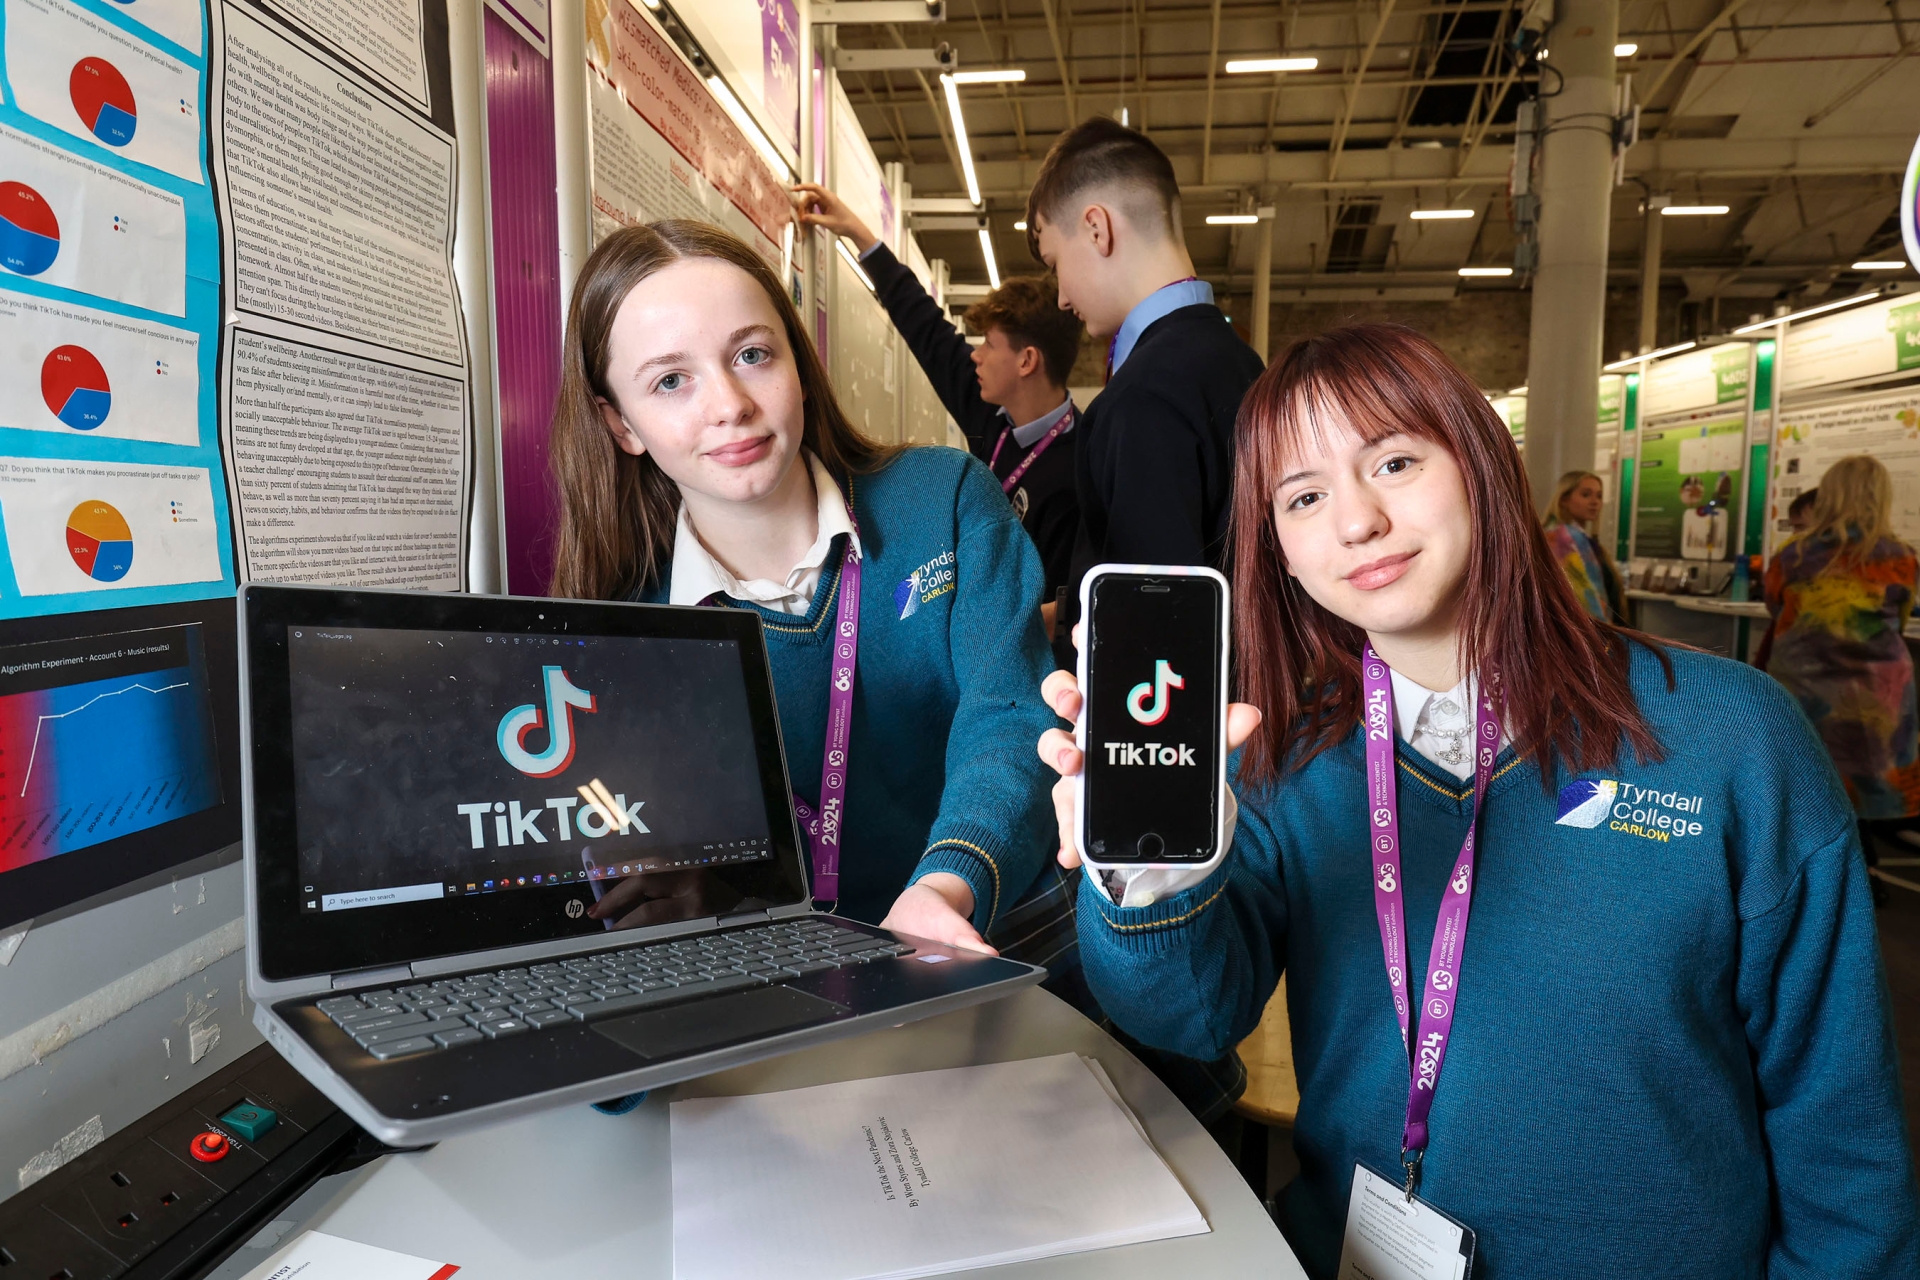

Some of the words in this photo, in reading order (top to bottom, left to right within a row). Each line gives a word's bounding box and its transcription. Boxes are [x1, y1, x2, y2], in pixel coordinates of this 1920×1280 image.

[66, 9, 79, 20] ever
[79, 16, 97, 29] made
[97, 26, 108, 36] you
[109, 31, 132, 49] question
[132, 44, 144, 55] your
[145, 51, 165, 67] physical
[227, 46, 250, 68] health,
[251, 62, 282, 87] wellbeing,
[227, 34, 245, 50] After
[246, 46, 276, 71] analysing
[293, 74, 303, 86] the
[303, 81, 321, 97] results
[331, 97, 357, 117] concluded
[227, 63, 237, 74] do
[238, 70, 253, 83] with
[253, 79, 275, 96] mental
[226, 78, 249, 96] others.
[274, 103, 286, 117] that
[336, 82, 373, 112] Conclusions
[226, 120, 266, 147] dysmorphia,
[5, 131, 40, 151] normalises
[42, 146, 97, 174] strange/potentially
[147, 189, 181, 207] unacceptable
[227, 148, 240, 161] that
[241, 154, 266, 173] TikTok
[266, 167, 280, 178] also
[228, 162, 265, 188] influencing
[238, 250, 273, 271] homework.
[239, 279, 255, 294] They
[255, 286, 271, 297] can't
[271, 289, 287, 301] focus
[9, 300, 21, 308] you
[23, 302, 38, 312] think
[40, 305, 60, 317] TikTok
[61, 310, 72, 319] has
[73, 313, 90, 323] made
[90, 318, 102, 326] you
[114, 323, 147, 335] insecure/self
[239, 294, 250, 304] the
[249, 296, 277, 313] (mostly)
[277, 304, 295, 317] 15-30
[294, 310, 315, 322] second
[237, 349, 259, 362] 90.4%
[266, 357, 292, 369] students
[235, 395, 253, 407] More
[254, 399, 268, 408] than
[268, 400, 281, 410] half
[291, 404, 324, 417] participants
[246, 518, 261, 527] make
[266, 518, 295, 527] difference.
[1, 662, 40, 675] Algorithm
[42, 656, 84, 668] Experiment
[89, 651, 117, 662] Account
[127, 647, 146, 656] Music
[146, 644, 170, 654] (results)
[1104, 742, 1196, 766] TikTok
[1619, 783, 1703, 814] Tyndall
[457, 793, 651, 849] TikTok
[1610, 820, 1671, 843] CARLOW
[1613, 802, 1703, 837] College
[567, 899, 582, 918] hp
[1443, 917, 1452, 941] SCIENTIST
[1440, 942, 1448, 961] YOUNG
[1447, 931, 1458, 964] TECHNOLOGY
[861, 1125, 878, 1153] Pandemic?
[901, 1128, 913, 1147] Carlow
[873, 1151, 882, 1165] Next
[877, 1164, 886, 1174] the
[891, 1154, 901, 1164] and
[909, 1147, 922, 1167] College
[880, 1174, 893, 1195] TikTok
[904, 1182, 914, 1198] Wren
[915, 1167, 931, 1188] Tyndall
[909, 1199, 919, 1208] By
[1364, 1186, 1377, 1198] Terms
[1376, 1194, 1385, 1202] and
[1384, 1199, 1407, 1216] Conditions
